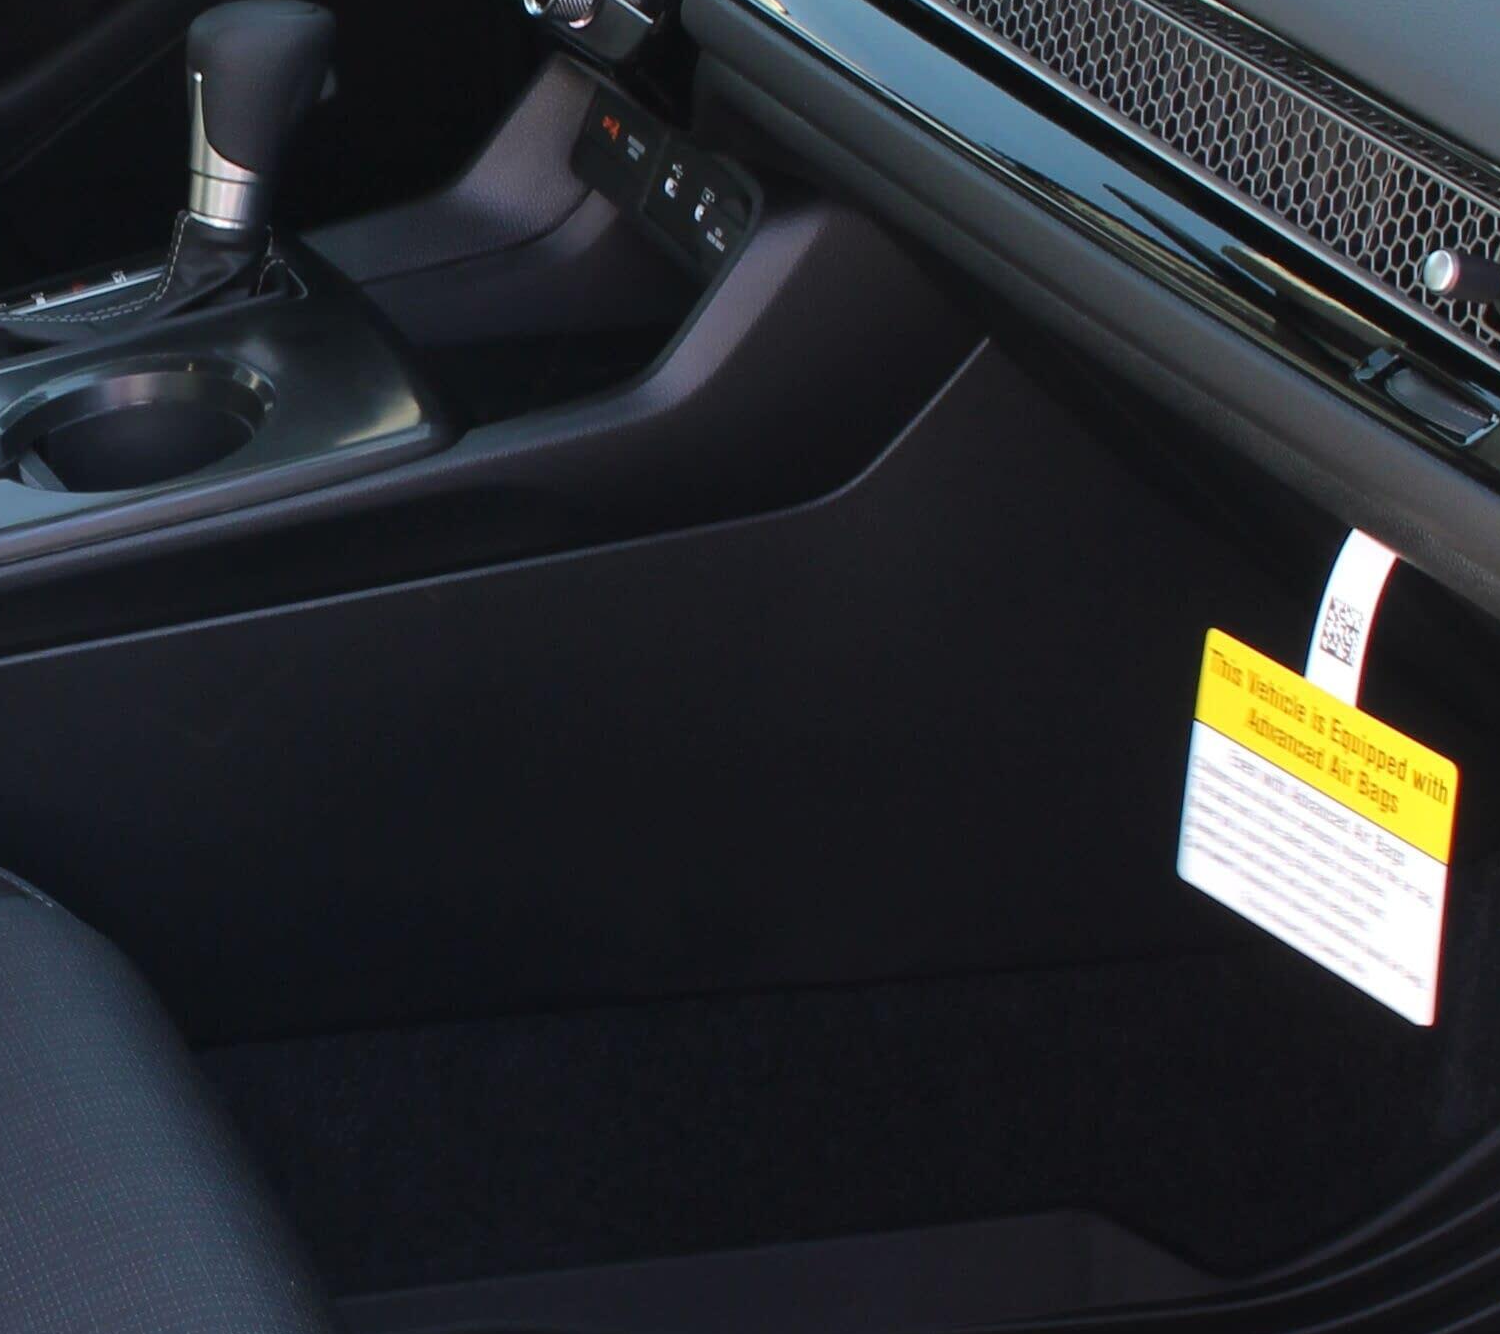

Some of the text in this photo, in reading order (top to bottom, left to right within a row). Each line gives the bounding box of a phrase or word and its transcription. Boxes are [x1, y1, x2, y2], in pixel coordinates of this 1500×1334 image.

[1209, 648, 1449, 805] This Vehicle is Equipped with
[1246, 707, 1400, 814] Advanced Air Bags
